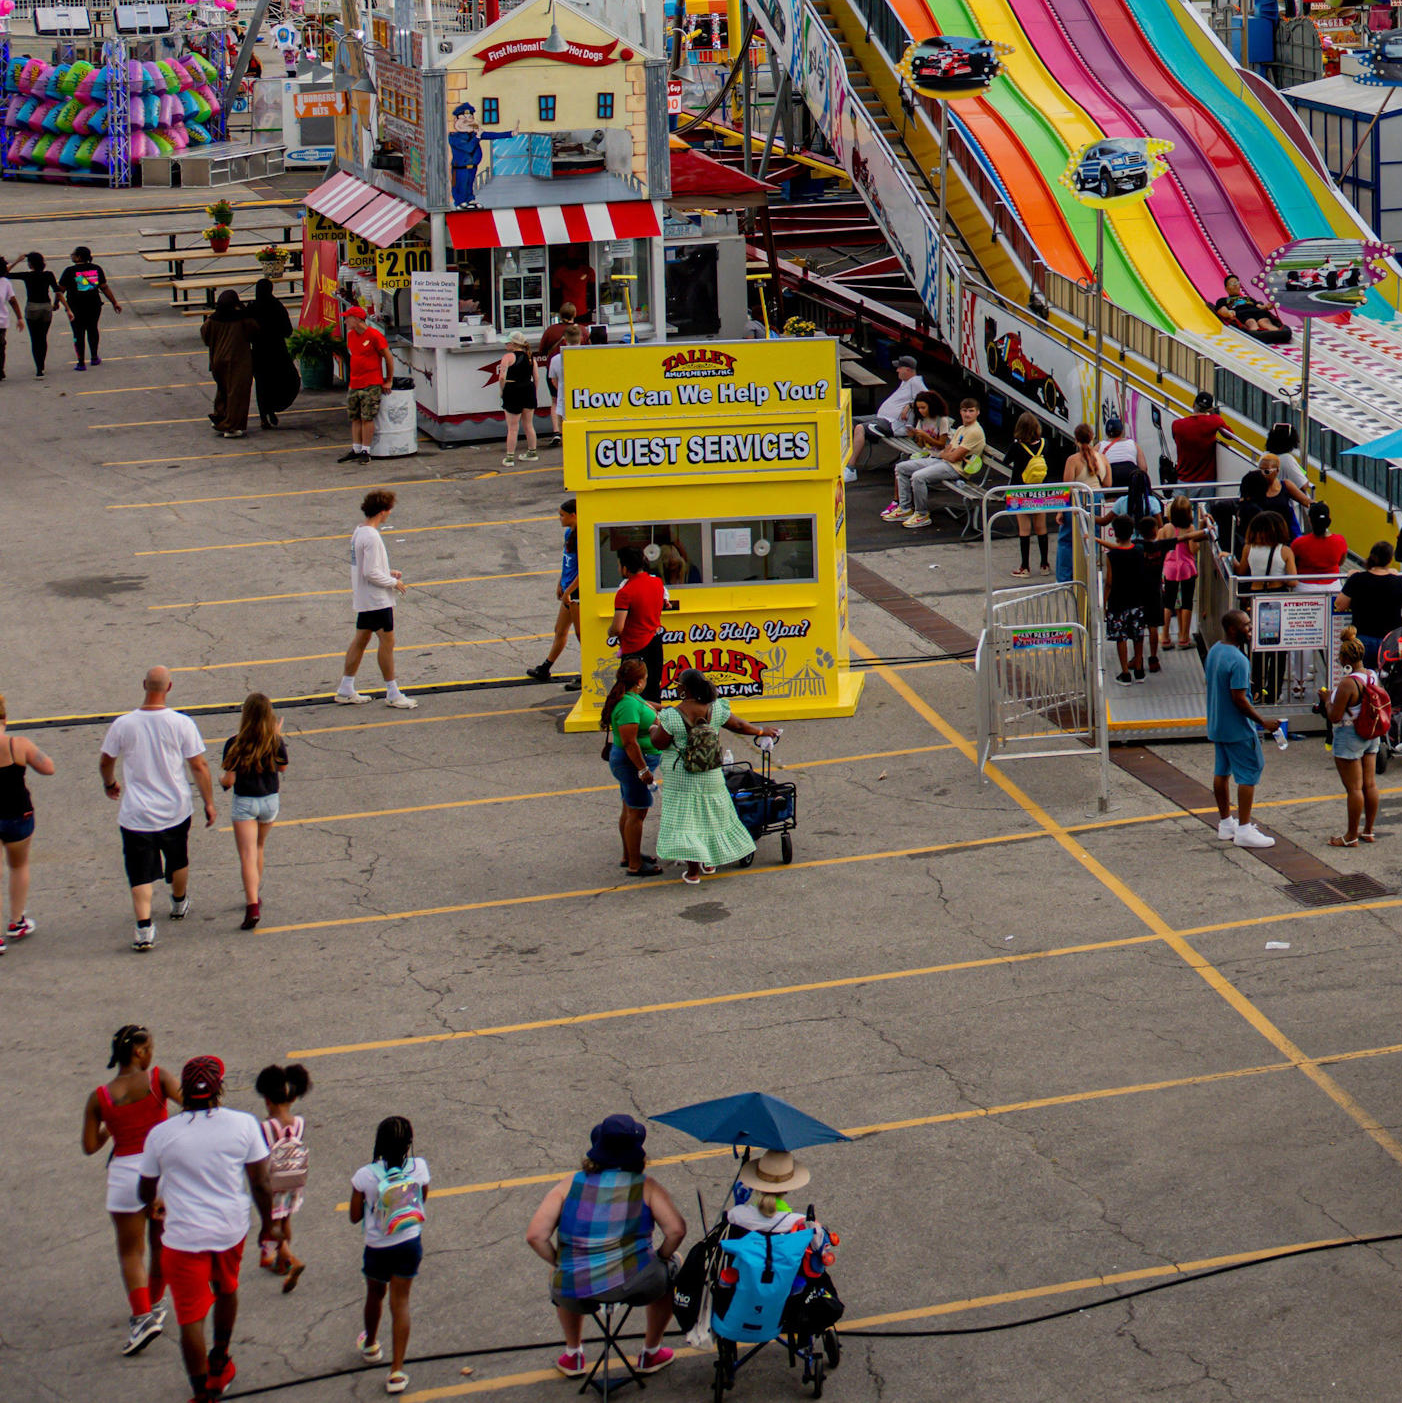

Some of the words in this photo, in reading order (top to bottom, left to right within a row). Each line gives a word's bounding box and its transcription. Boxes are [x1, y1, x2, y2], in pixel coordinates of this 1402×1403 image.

[488, 48, 507, 62] First
[506, 41, 540, 54] National
[569, 46, 583, 58] Hot
[582, 49, 604, 63] Dogs
[303, 93, 336, 103] BURGERS
[312, 233, 328, 241] HOT
[348, 258, 375, 266] CORN
[378, 250, 432, 277] $2.00
[381, 279, 400, 288] HOT
[441, 280, 456, 288] Deals
[662, 349, 738, 372] TALLEY
[572, 387, 626, 409] How
[630, 385, 672, 407] Can
[676, 384, 713, 406] We
[718, 382, 770, 405] Help
[774, 379, 829, 402] You?
[596, 436, 682, 467] GUEST
[687, 431, 811, 463] SERVICES
[1033, 491, 1046, 499] PASS
[689, 623, 714, 643] We
[718, 621, 760, 643] Help
[763, 619, 811, 642] You?
[660, 648, 769, 690] TALLEY
